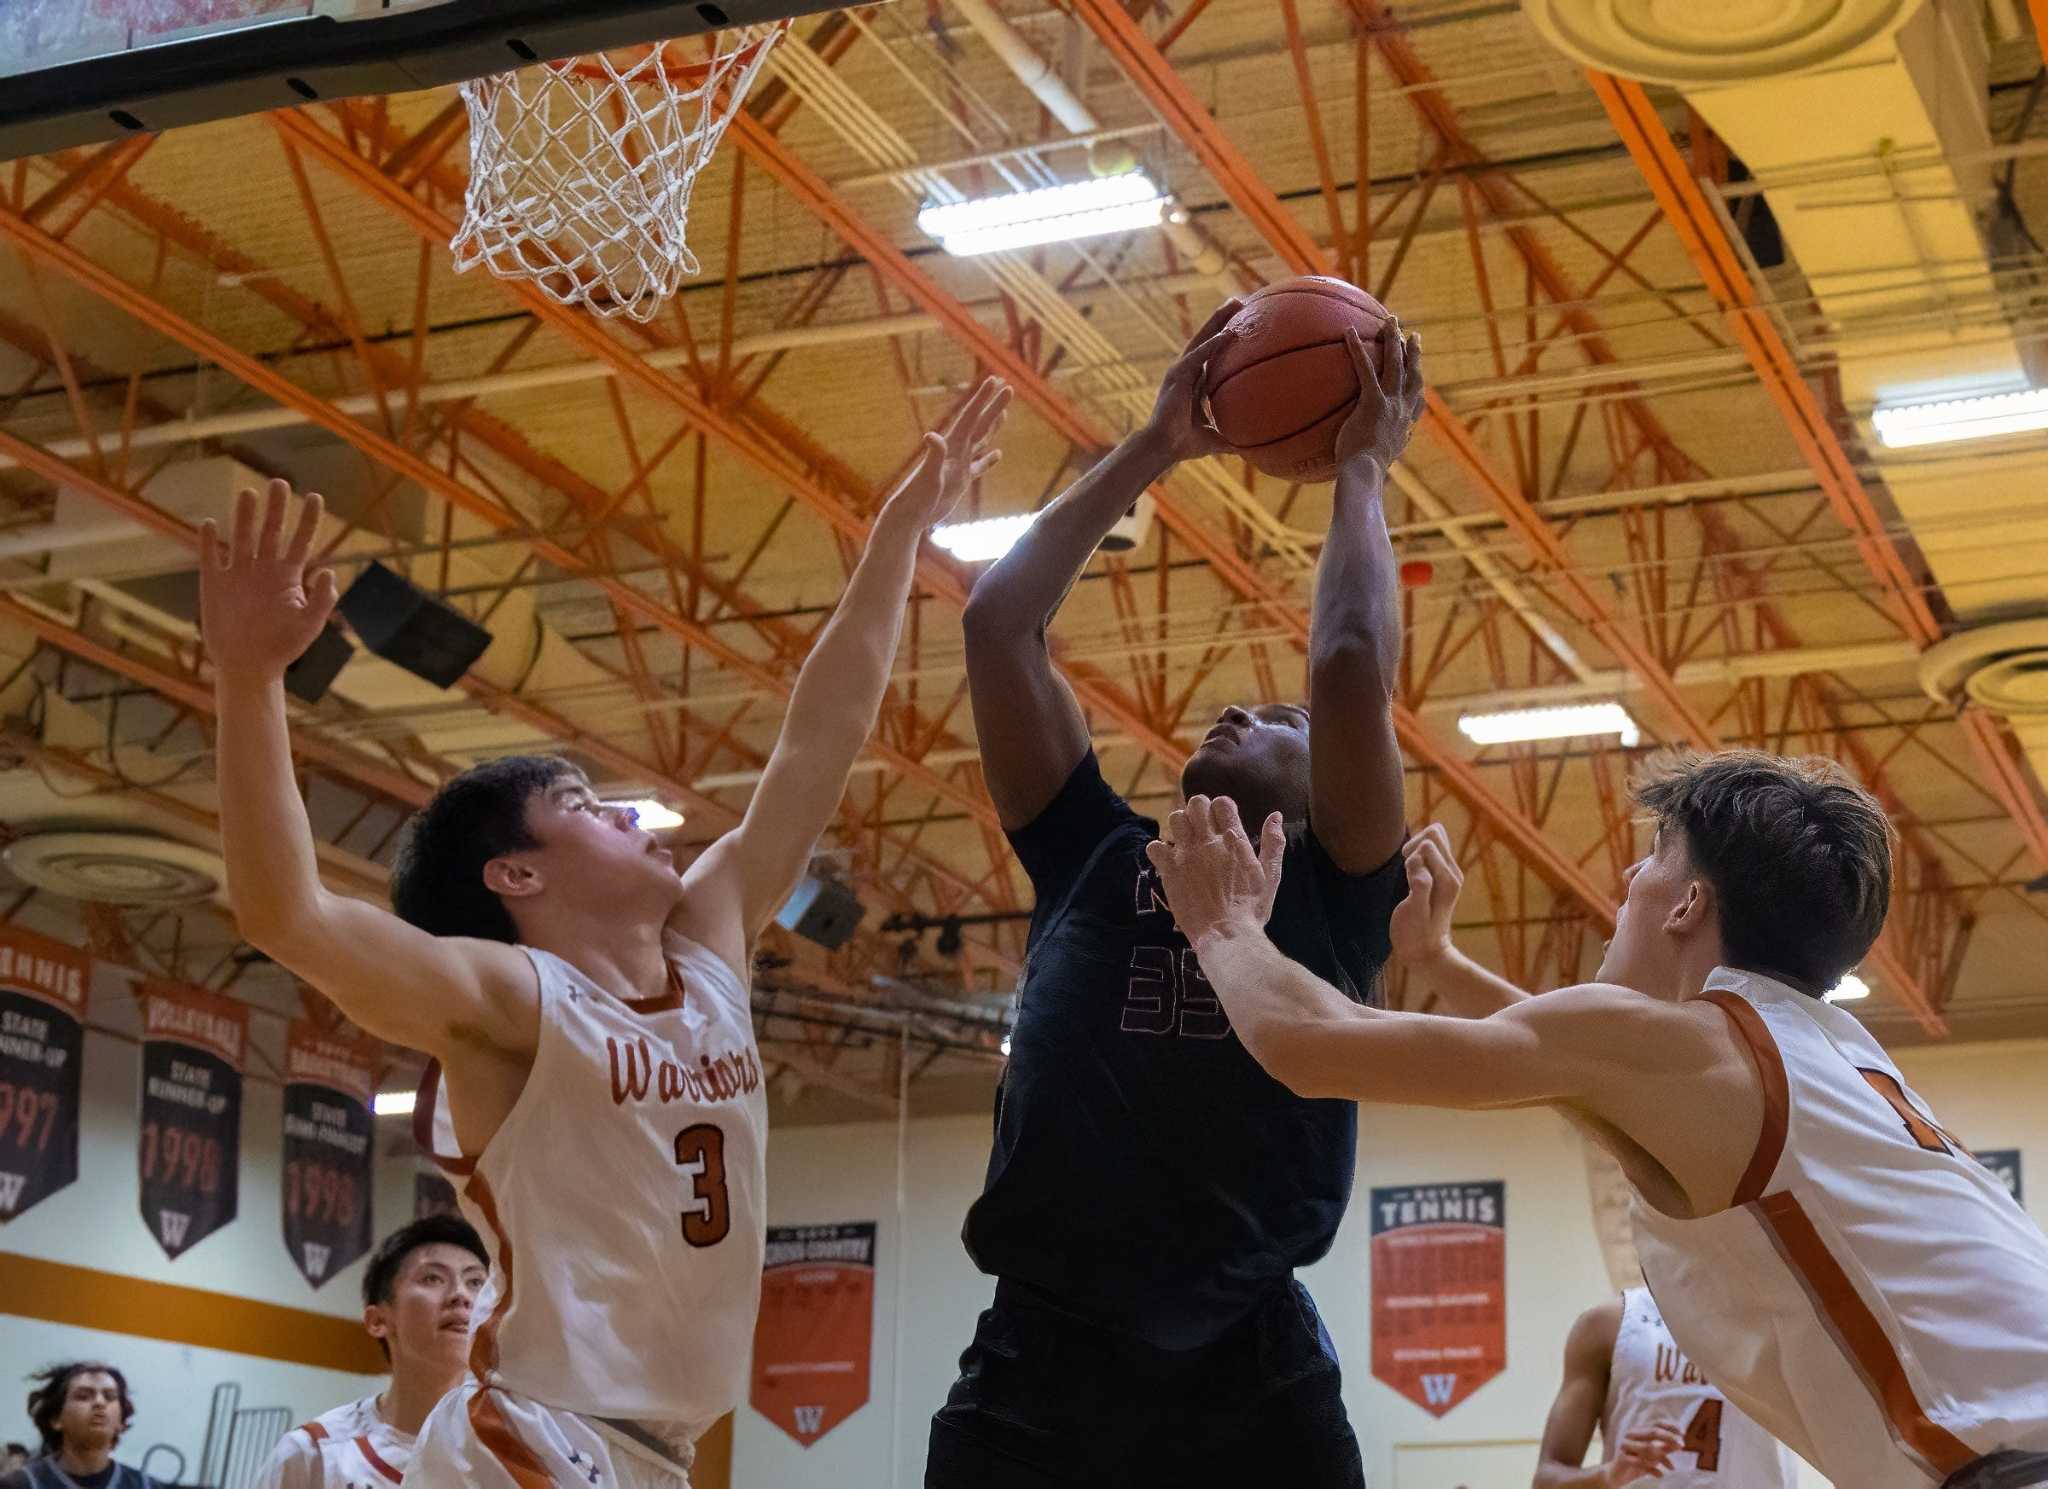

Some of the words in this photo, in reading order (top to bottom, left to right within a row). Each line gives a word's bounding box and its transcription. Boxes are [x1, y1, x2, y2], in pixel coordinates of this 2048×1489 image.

[2, 1010, 48, 1042] STATE
[170, 1060, 210, 1090] STATE
[673, 1122, 731, 1249] 3
[159, 1207, 192, 1248] W
[1380, 1196, 1496, 1227] TENNIS
[1420, 1372, 1458, 1405] W
[793, 1405, 825, 1434] W
[1682, 1398, 1724, 1472] 4
